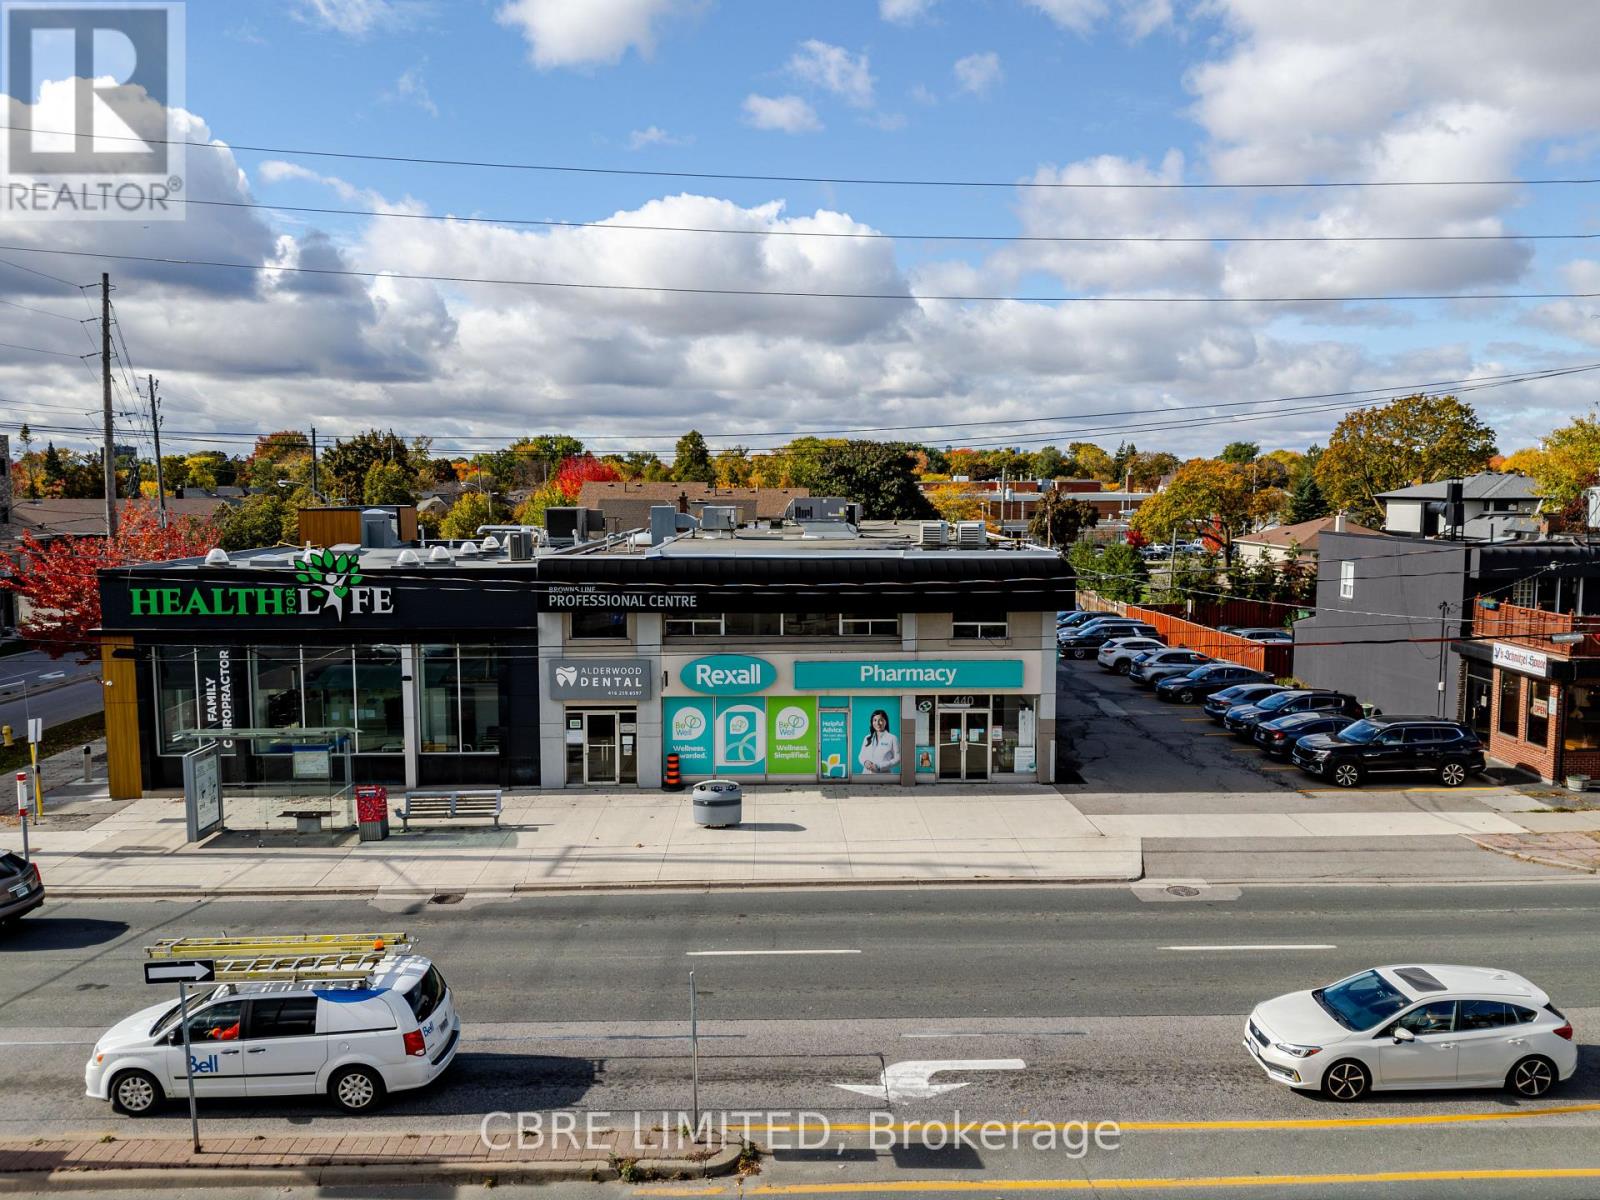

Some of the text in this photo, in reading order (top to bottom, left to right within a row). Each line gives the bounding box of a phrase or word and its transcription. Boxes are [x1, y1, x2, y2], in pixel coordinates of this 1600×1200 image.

[129, 588, 285, 616] HEALTH
[286, 587, 296, 614] FOR
[548, 594, 697, 607] PROFESSIONAL CENTRE
[580, 667, 642, 675] ALDERWOOD
[696, 664, 761, 687] Rexall
[860, 665, 957, 686] Pharmacy
[580, 677, 642, 687] DENTAL
[206, 677, 217, 722] FAMILY
[219, 650, 233, 748] CIROPRACTOR
[953, 695, 974, 705] 440
[190, 1054, 218, 1073] Bell
